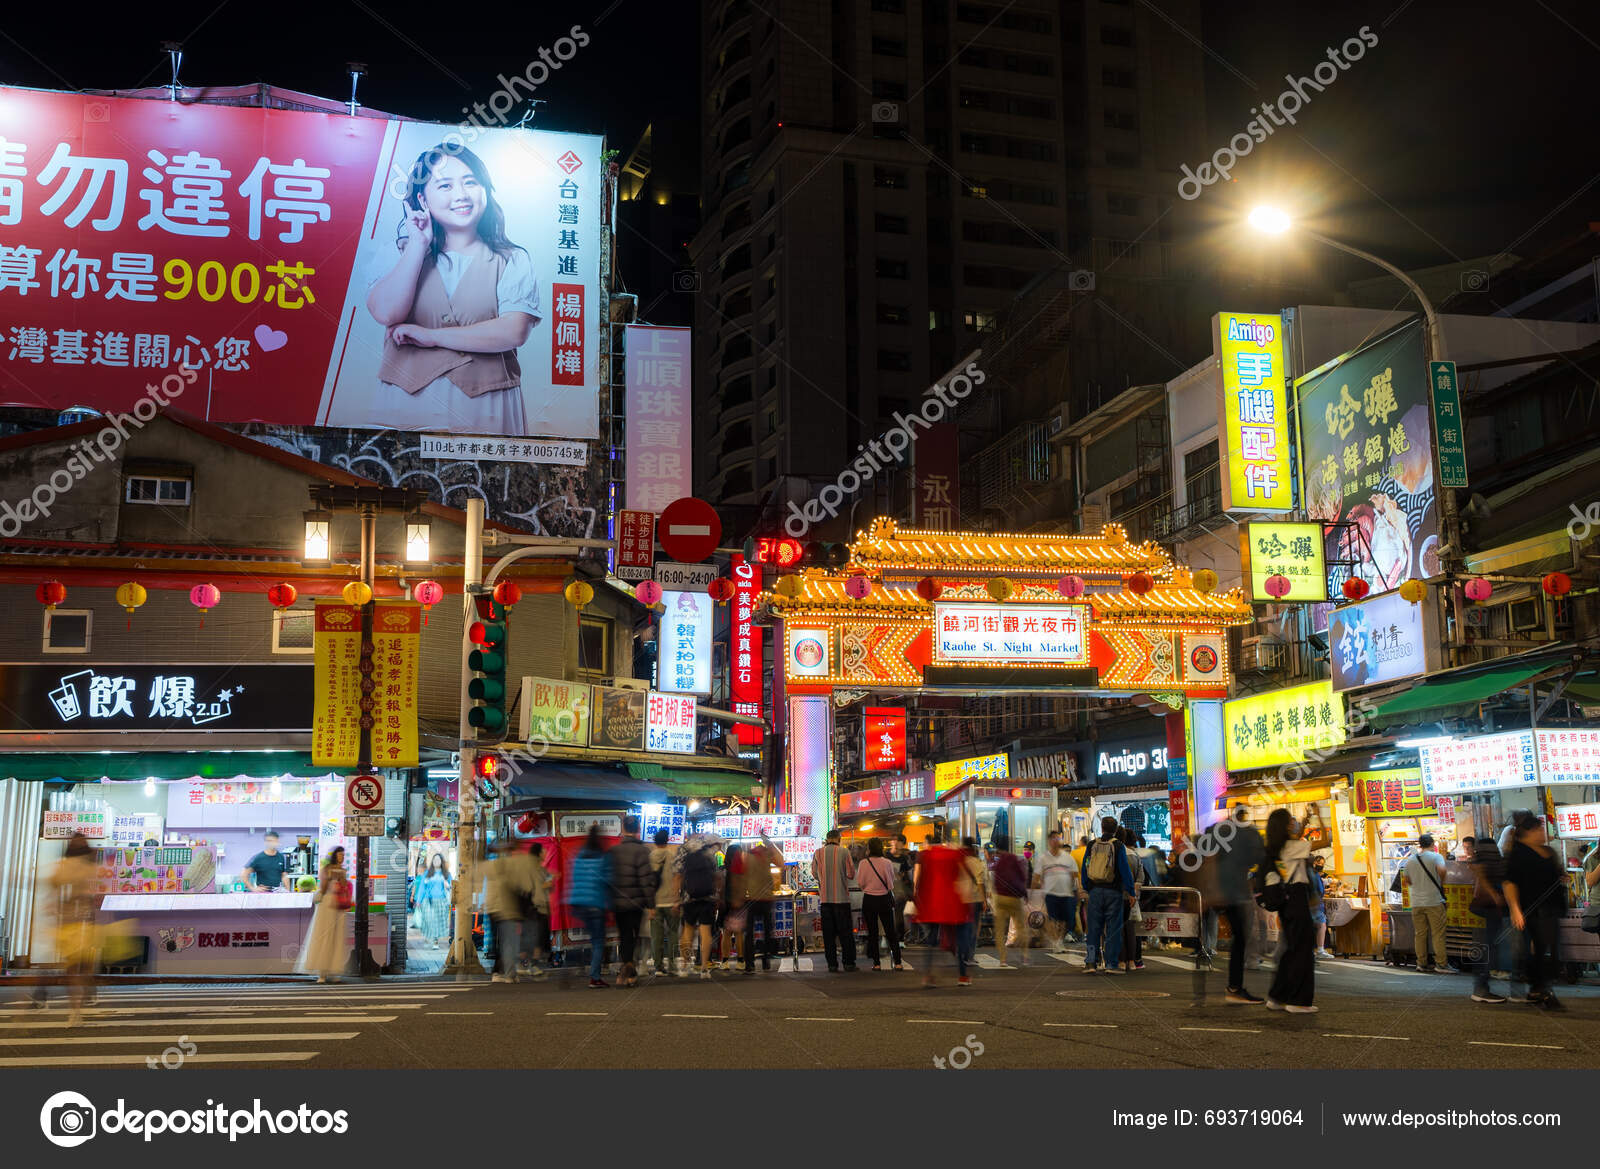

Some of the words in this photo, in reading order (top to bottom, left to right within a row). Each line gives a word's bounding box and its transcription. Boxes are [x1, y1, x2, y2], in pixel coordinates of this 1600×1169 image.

[557, 179, 580, 276] 台灣基進
[555, 293, 582, 375] 楊佩樺
[1227, 318, 1275, 348] Amigo
[0, 326, 251, 372] 灣基進關心您
[636, 332, 682, 512] 上順珠寶銀樓
[1437, 375, 1457, 444] 饒河街
[1237, 352, 1278, 499] 手機配件
[422, 439, 586, 461] 110北市都建廣字第005745號
[1321, 422, 1411, 486] 海鮮鍋燒
[1440, 445, 1462, 454] RaoHe
[1441, 455, 1449, 463] St
[623, 512, 636, 562] 禁止停車
[638, 513, 651, 564] 徒步區內
[658, 570, 716, 585] 16:00~24:00
[738, 591, 752, 683] 美夢成真鑽石
[943, 615, 1077, 634] 饒河街觀光夜市
[1371, 623, 1404, 652] 刺青
[675, 623, 696, 690] 韓式拍貼機
[943, 641, 977, 652] Raohe
[983, 641, 997, 652] St.
[1003, 642, 1032, 655] Night
[1039, 643, 1079, 653] Market
[89, 675, 196, 718] 飲爆
[197, 703, 222, 716] 2.0
[535, 682, 569, 709] 飲爆
[649, 697, 695, 728] 胡椒餅
[880, 732, 893, 756] 哈林
[1098, 750, 1146, 775] Amigo
[356, 783, 373, 801] 停
[1366, 777, 1462, 813] 營養三
[742, 816, 773, 836] 胡椒餅
[198, 933, 230, 947] 飲爆
